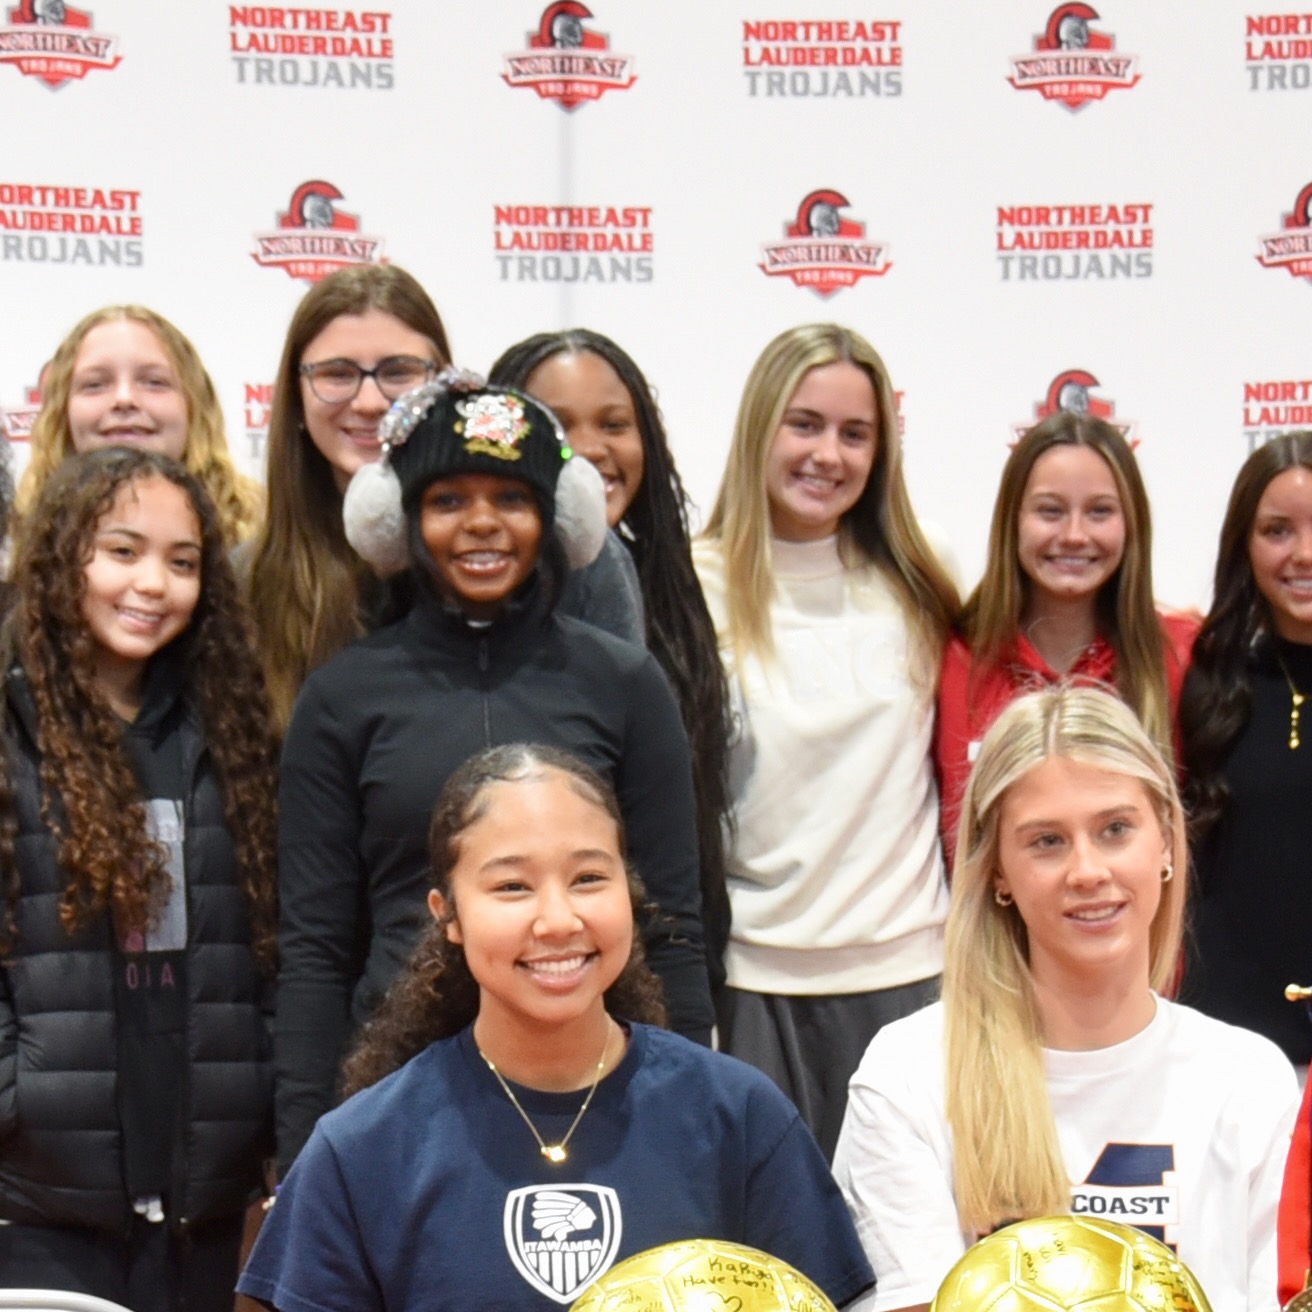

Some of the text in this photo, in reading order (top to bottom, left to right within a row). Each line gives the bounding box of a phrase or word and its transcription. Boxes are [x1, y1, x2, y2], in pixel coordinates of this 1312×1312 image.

[229, 5, 391, 33] NORTHEAST
[742, 20, 900, 42] NORTHEAST
[230, 31, 393, 58] LAUDERDALE
[743, 46, 902, 67] LAUDERDALE
[232, 56, 393, 89] TROJANS
[505, 55, 624, 81] NORTHEAST
[1016, 57, 1131, 82] NORTHEAST
[744, 70, 903, 98] TROJANS
[494, 205, 652, 228] NORTHEAST
[997, 203, 1153, 227] NORTHEAST
[258, 236, 376, 260] NORTHEAST
[494, 230, 654, 253] LAUDERDALE
[997, 228, 1153, 251] LAUDERDALE
[768, 242, 882, 266] NORTHEAST
[999, 251, 1153, 280] TROJANS
[497, 255, 654, 283] TROJANS
[1071, 1194, 1169, 1215] COAST
[525, 1238, 603, 1253] ITAWAMBA
